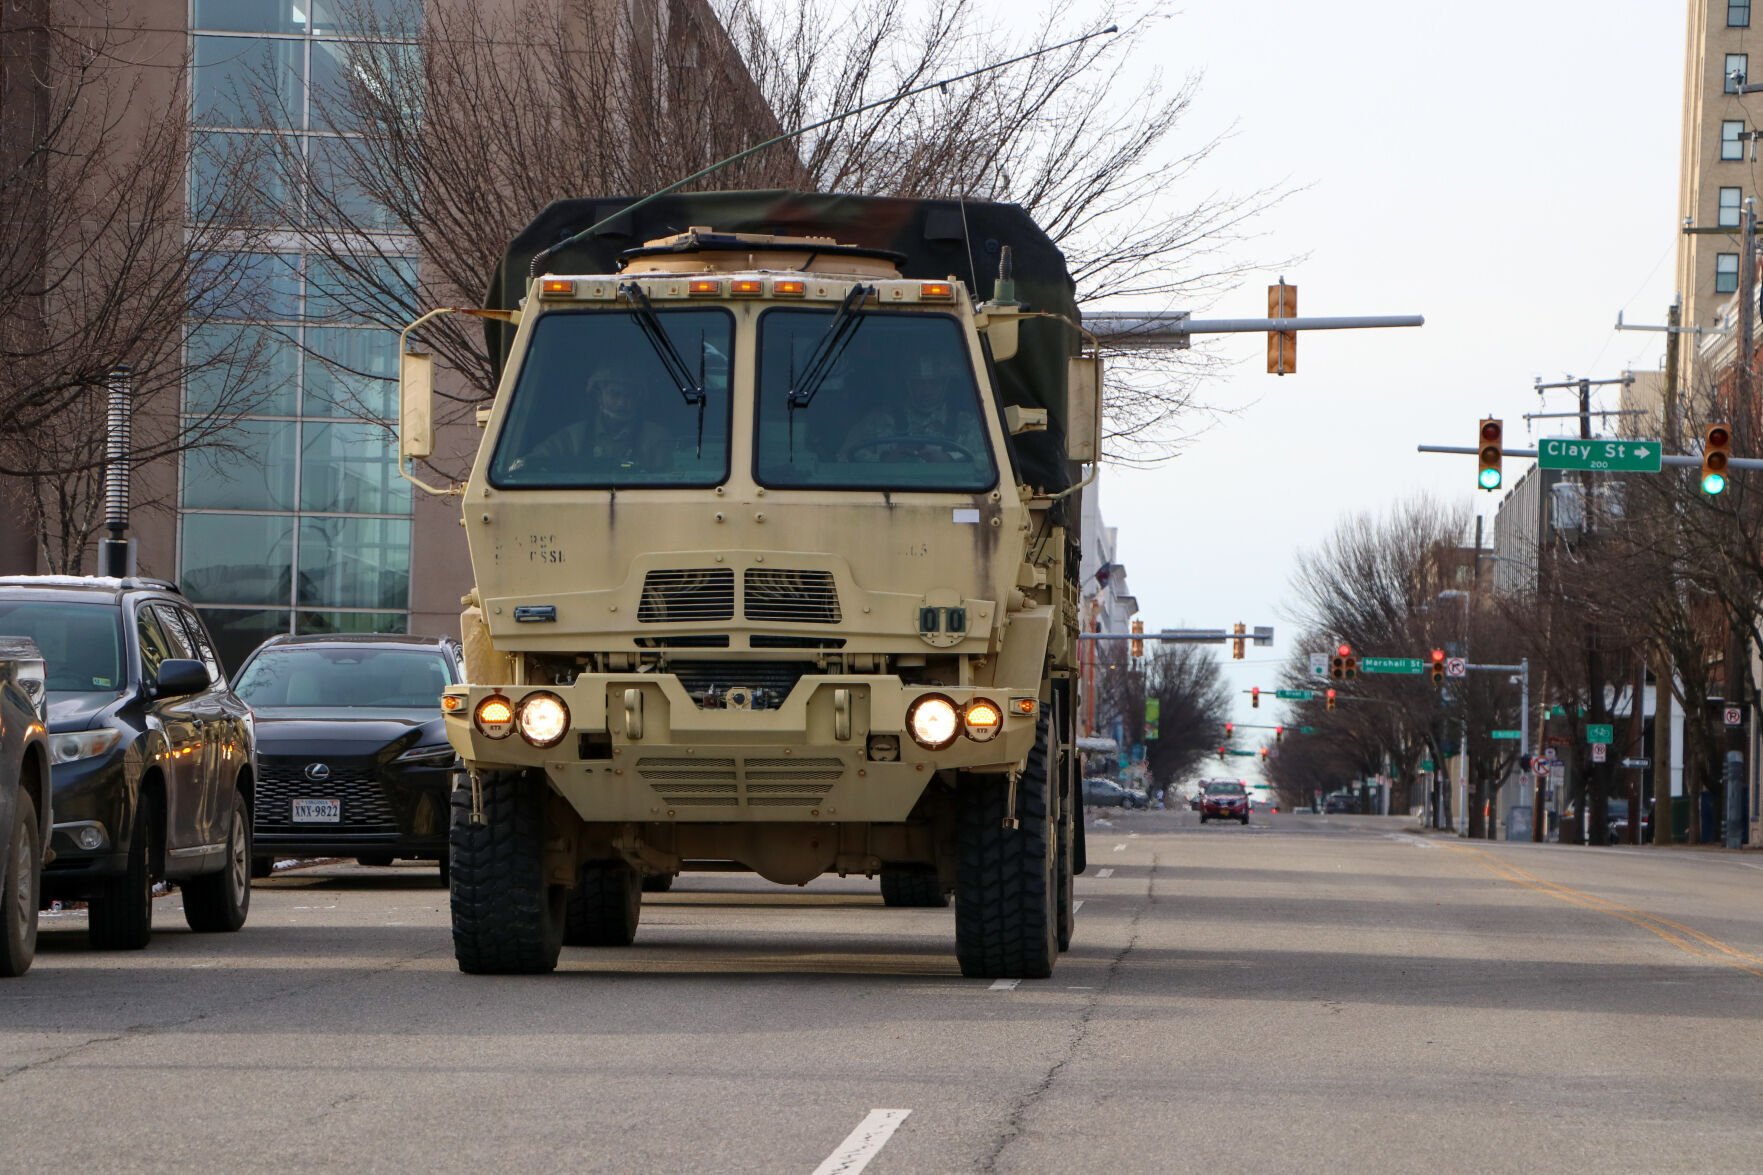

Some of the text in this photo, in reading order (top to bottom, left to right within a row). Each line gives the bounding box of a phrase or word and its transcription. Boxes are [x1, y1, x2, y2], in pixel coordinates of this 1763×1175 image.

[1547, 441, 1625, 460] Clay St
[1590, 460, 1608, 469] 200
[1365, 658, 1420, 668] Marshall St
[295, 805, 338, 817] XNX-9822
